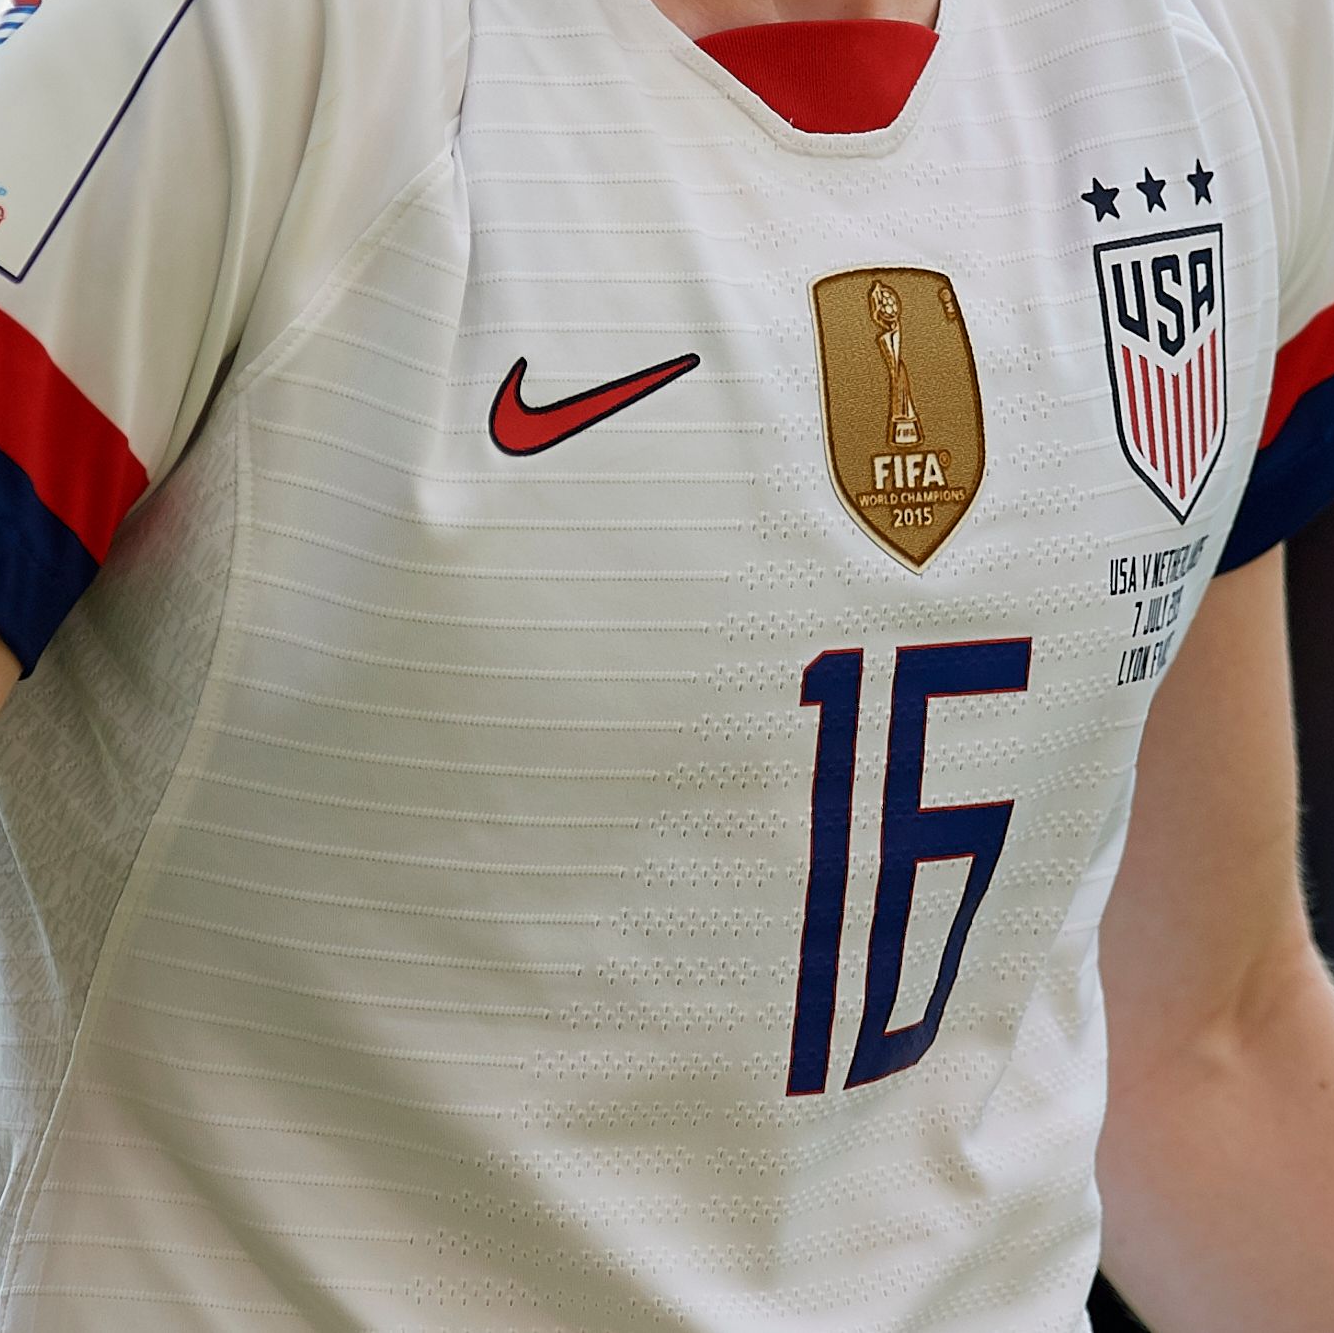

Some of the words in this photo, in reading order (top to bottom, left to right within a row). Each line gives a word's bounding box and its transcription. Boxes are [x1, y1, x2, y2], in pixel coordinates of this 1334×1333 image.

[1110, 246, 1215, 357] USA
[873, 453, 945, 489] FIFA
[859, 493, 898, 507] WORLD
[900, 490, 966, 504] CHAMPIONS
[893, 507, 933, 527] 2015
[1110, 555, 1136, 596] USA
[1142, 553, 1152, 590] V
[1132, 601, 1143, 638] 7
[1117, 645, 1151, 686] LYON
[786, 636, 1032, 1097] 16
